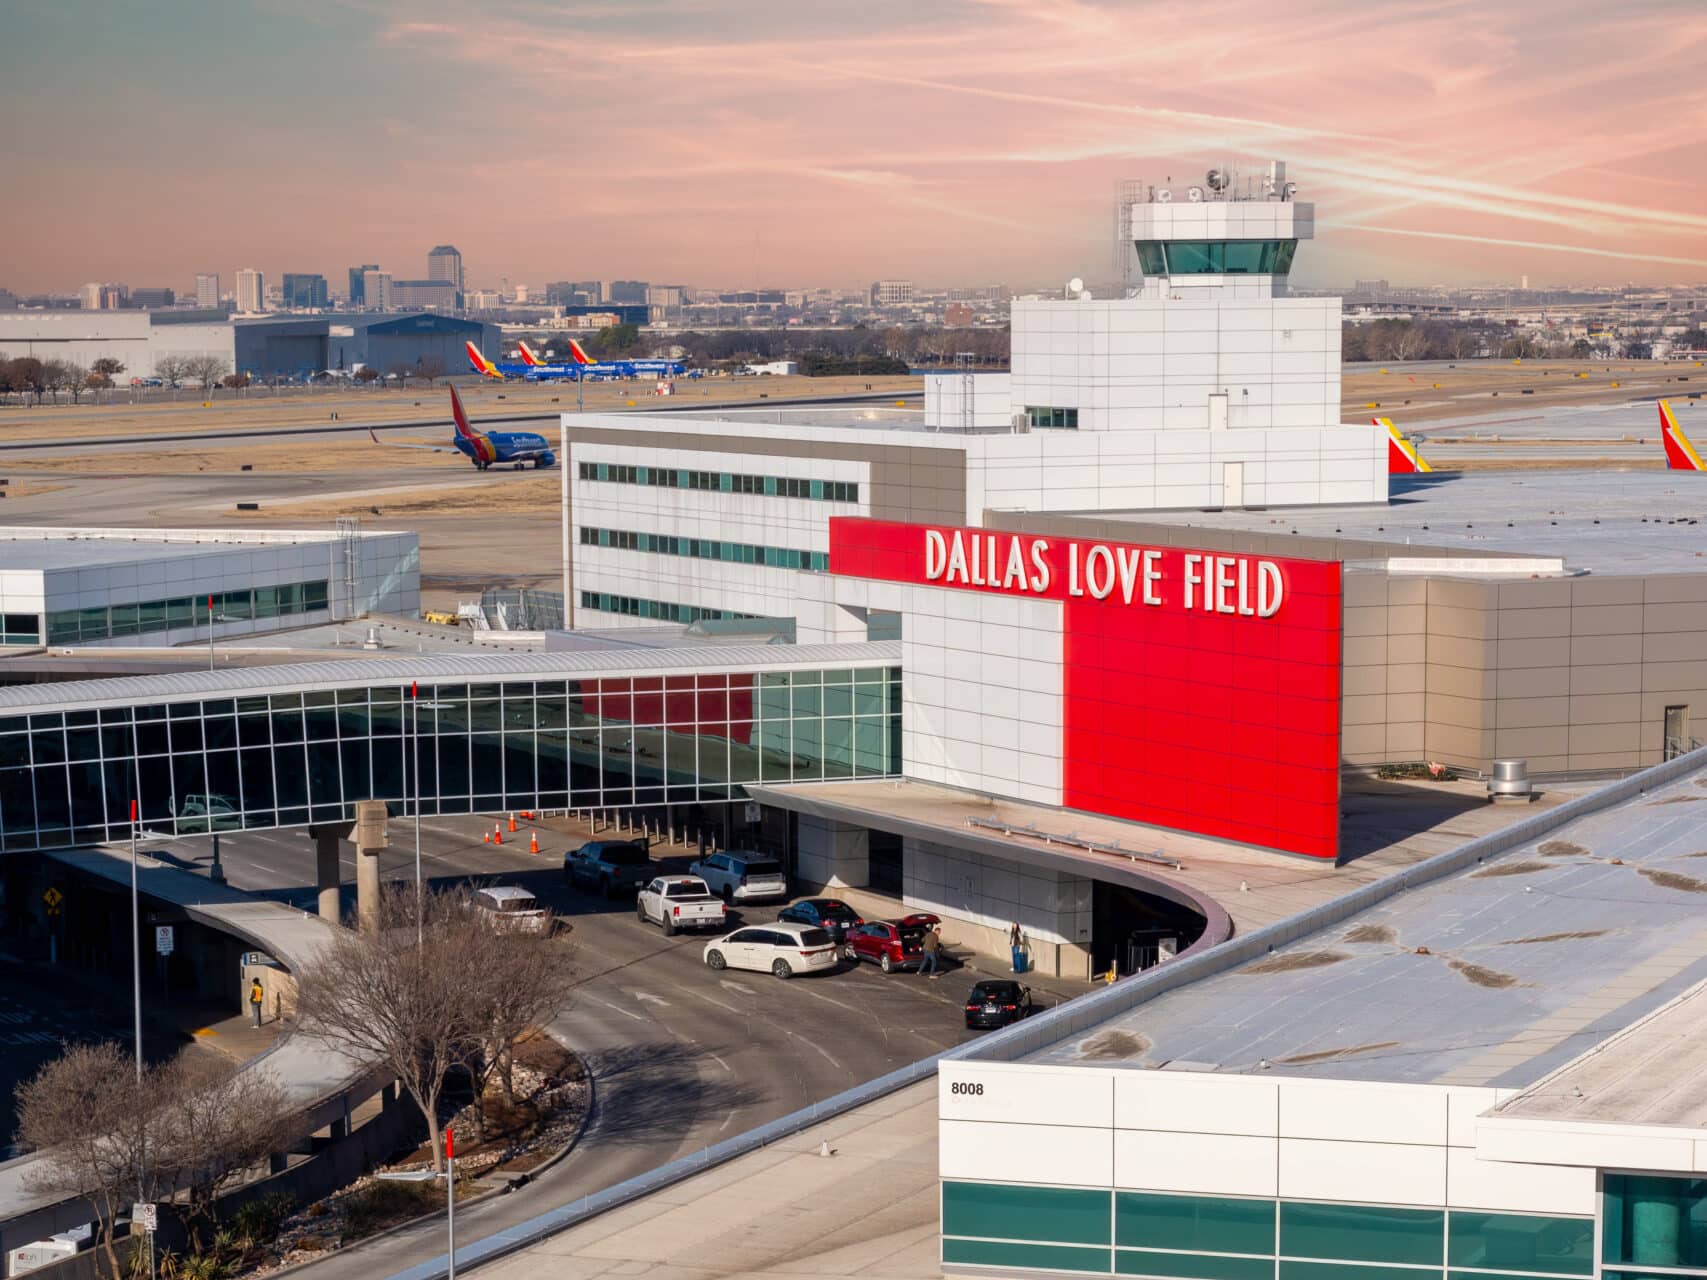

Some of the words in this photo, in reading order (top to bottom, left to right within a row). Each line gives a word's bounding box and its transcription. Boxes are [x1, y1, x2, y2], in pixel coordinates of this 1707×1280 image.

[926, 529, 1050, 593] DALLAS
[1069, 544, 1162, 606] LOVE
[1184, 554, 1283, 618] FIELD
[951, 1082, 984, 1096] 8008
